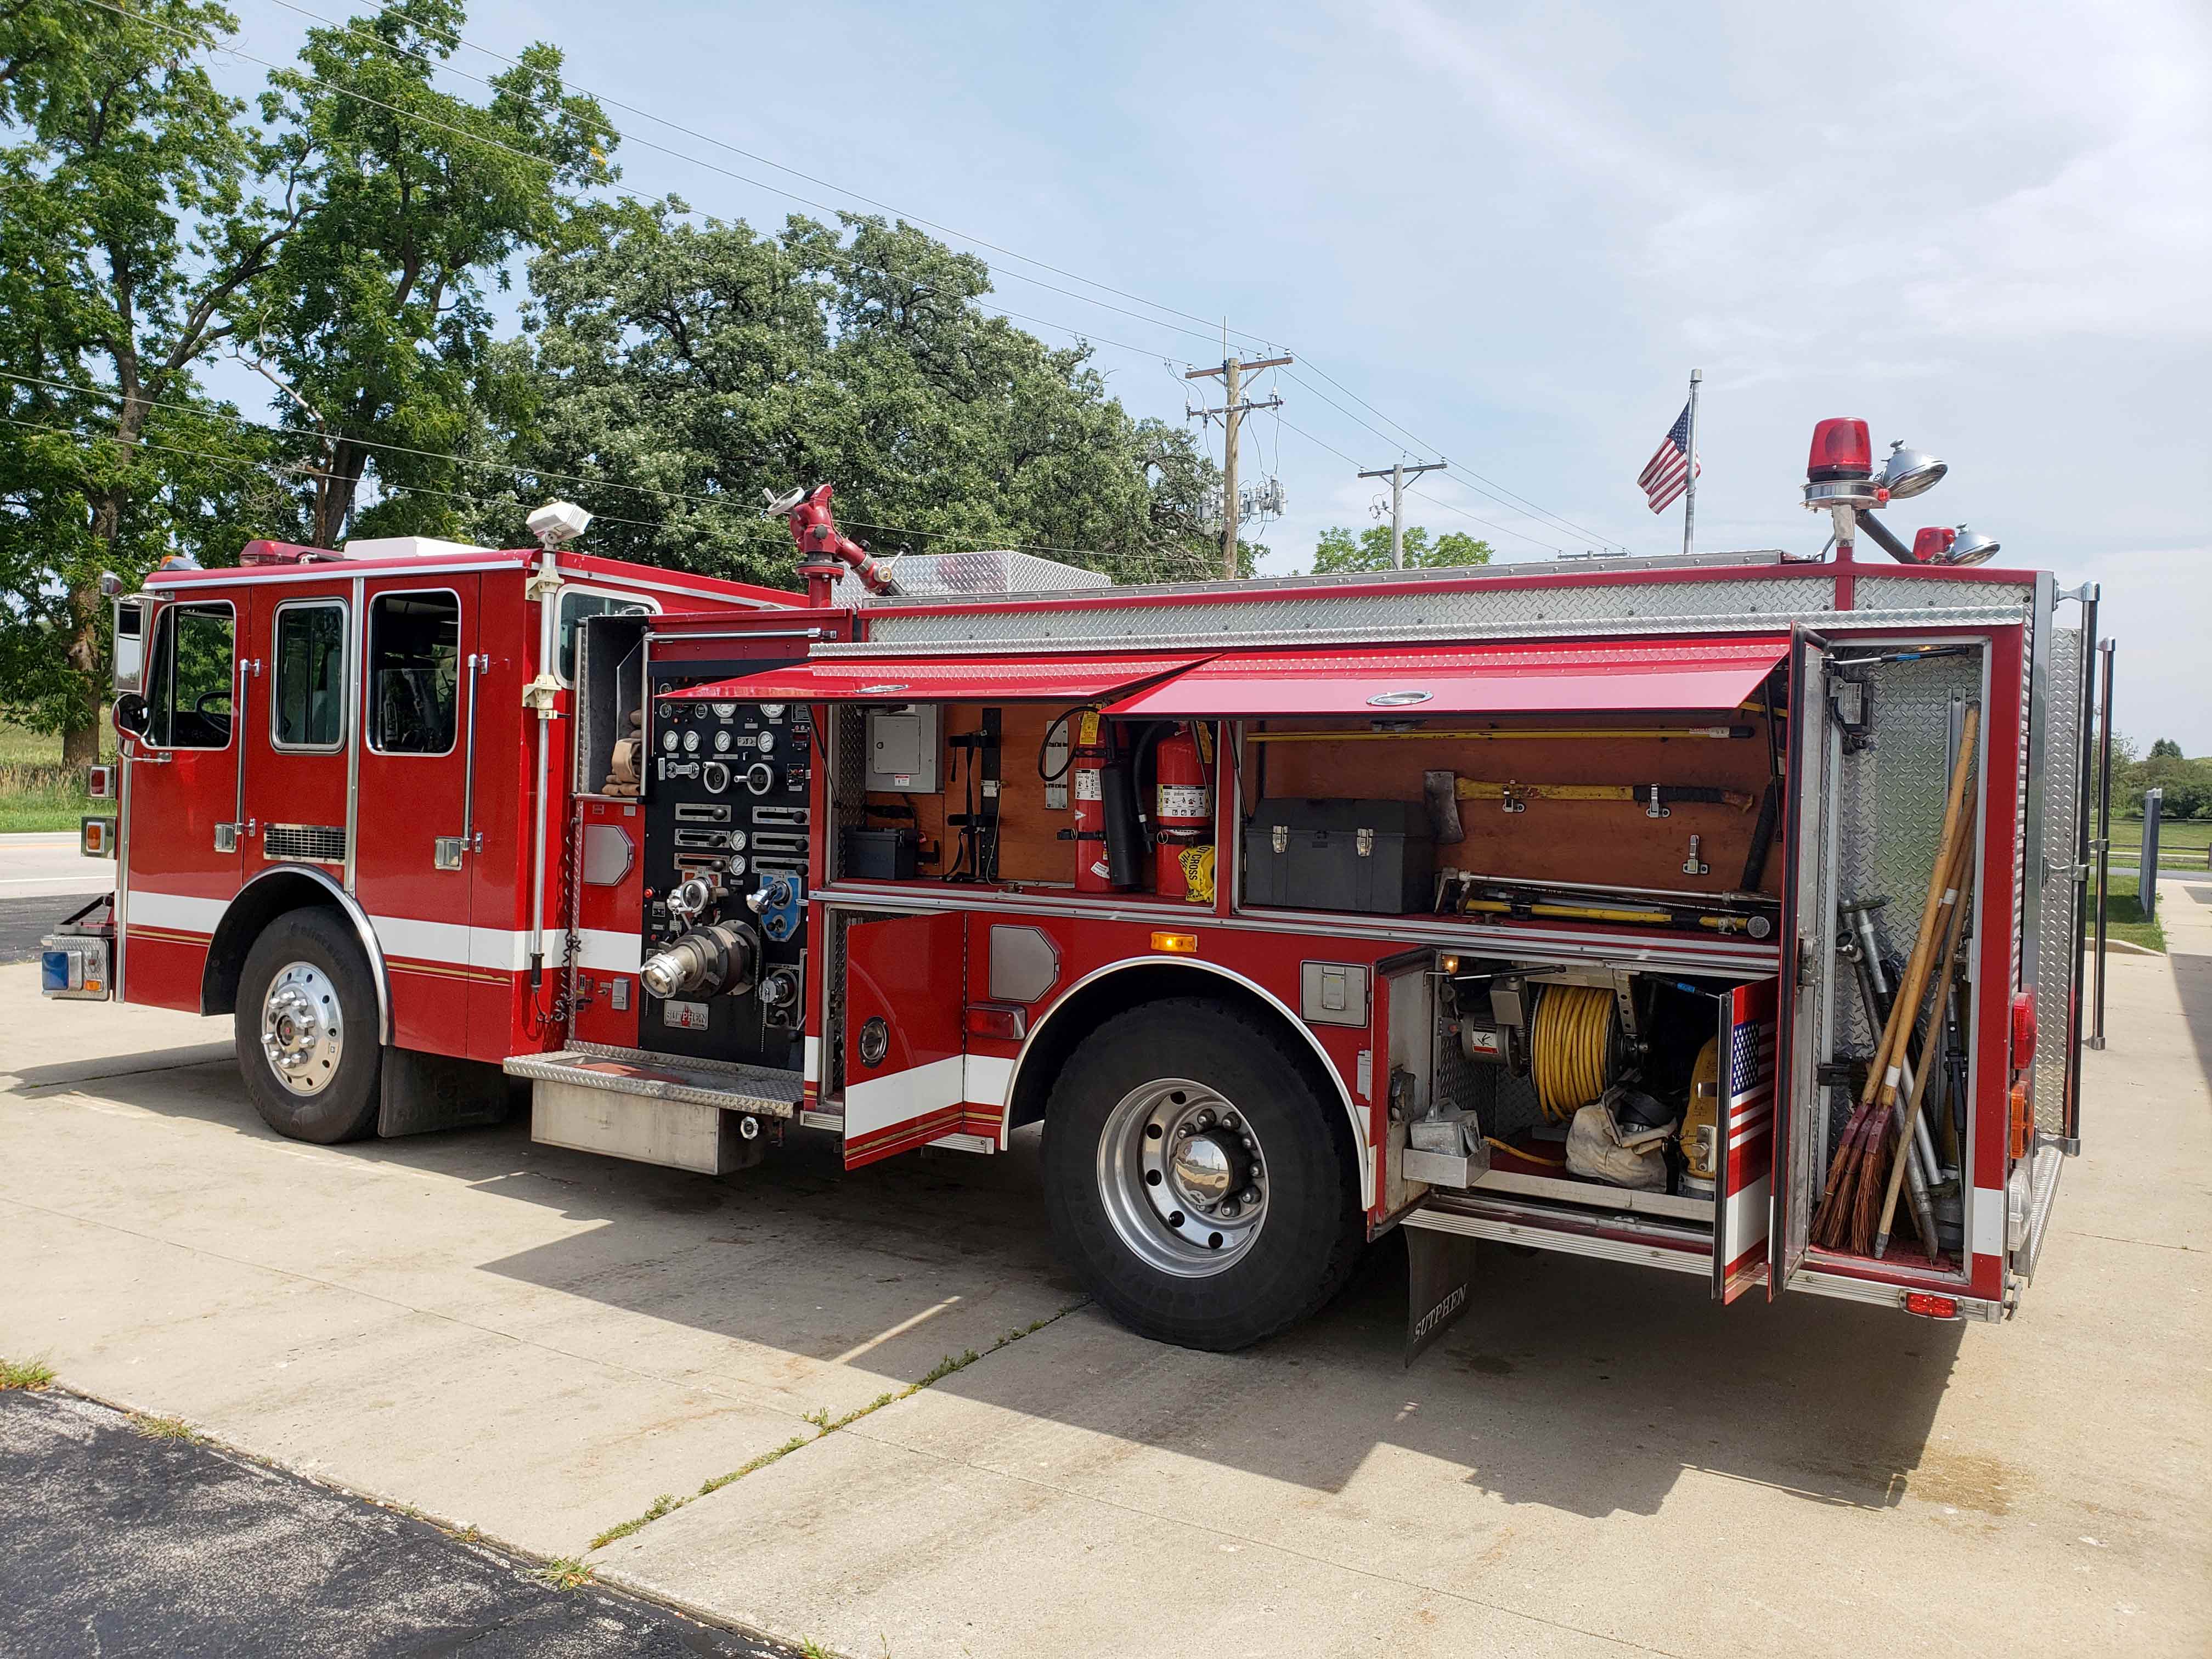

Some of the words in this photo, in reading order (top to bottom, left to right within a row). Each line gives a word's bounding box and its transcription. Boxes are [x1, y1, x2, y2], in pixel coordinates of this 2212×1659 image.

[1189, 854, 1201, 880] CROSS
[667, 1011, 707, 1023] SUTPHEN
[1413, 1283, 1468, 1344] SUTPHEN
